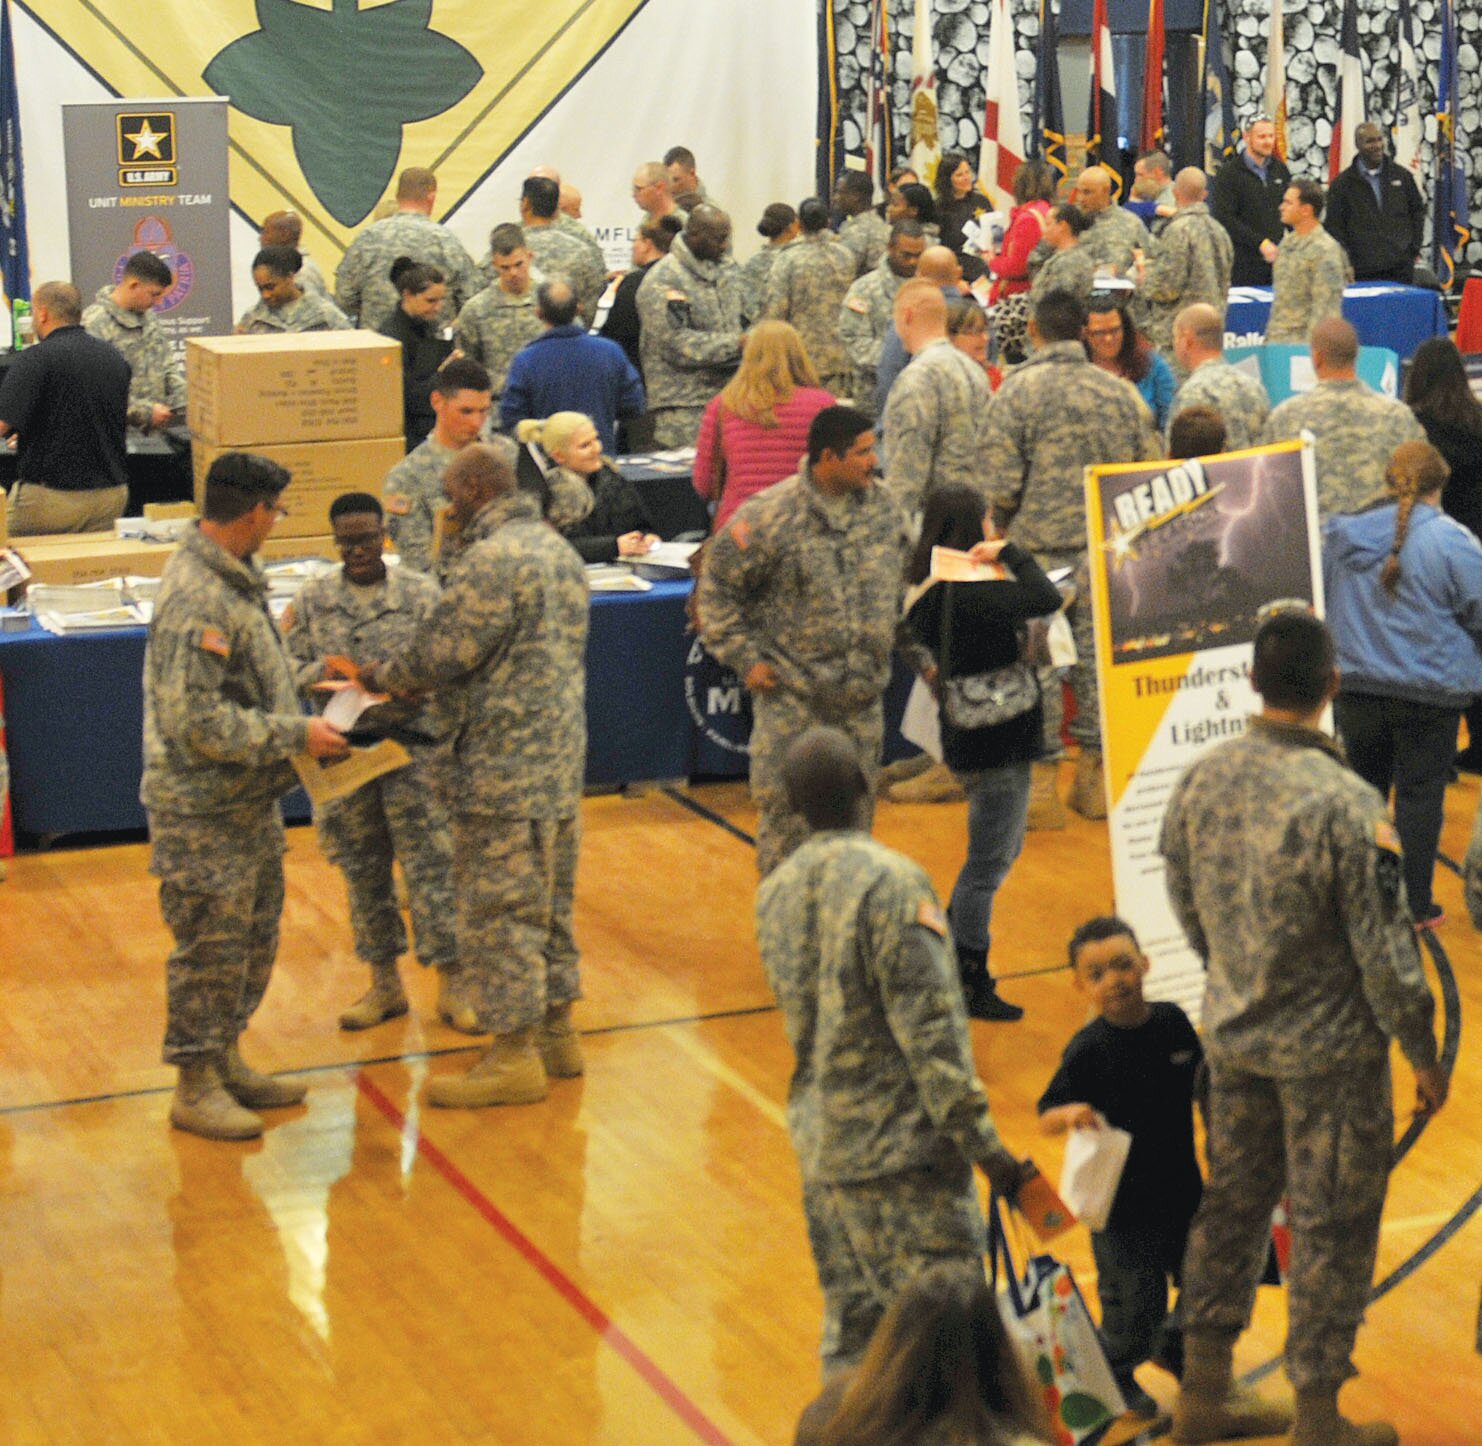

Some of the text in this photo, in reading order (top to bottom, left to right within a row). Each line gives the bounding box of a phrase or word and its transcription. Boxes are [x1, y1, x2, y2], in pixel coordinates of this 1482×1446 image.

[88, 194, 212, 208] UNIT MINISTRY TEAM
[1113, 458, 1209, 530] READY
[1133, 661, 1251, 698] Thunderst
[1214, 689, 1230, 710] &
[1170, 712, 1251, 746] Lightni
